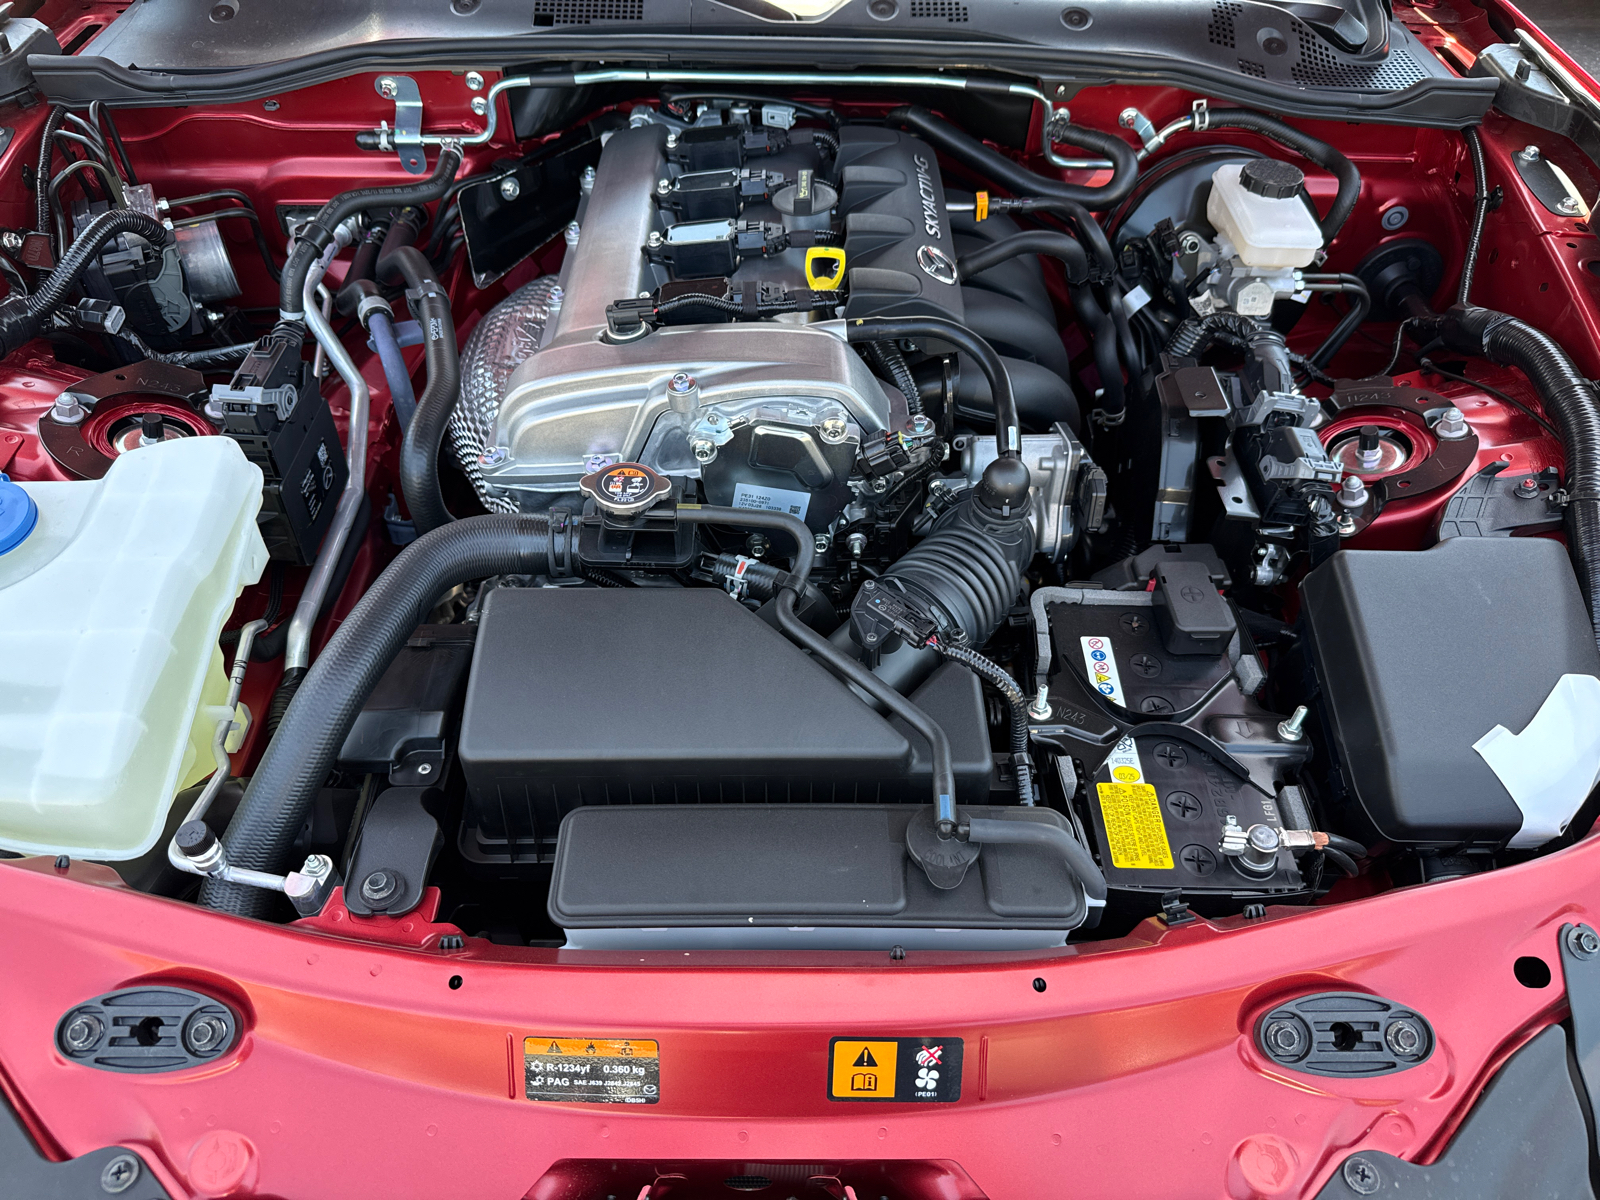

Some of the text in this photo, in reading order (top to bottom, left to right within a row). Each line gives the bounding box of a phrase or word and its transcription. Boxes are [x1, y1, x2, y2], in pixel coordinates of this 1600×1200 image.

[914, 154, 941, 239] SKYACTIV-G
[66, 445, 84, 457] R
[1056, 705, 1087, 725] N243
[1111, 757, 1135, 765] 140325E
[1120, 795, 1131, 815] POISON
[1148, 798, 1161, 822] DANGER
[546, 1063, 646, 1076] R-1234yf 0.360 kg
[547, 1078, 570, 1086] PAG
